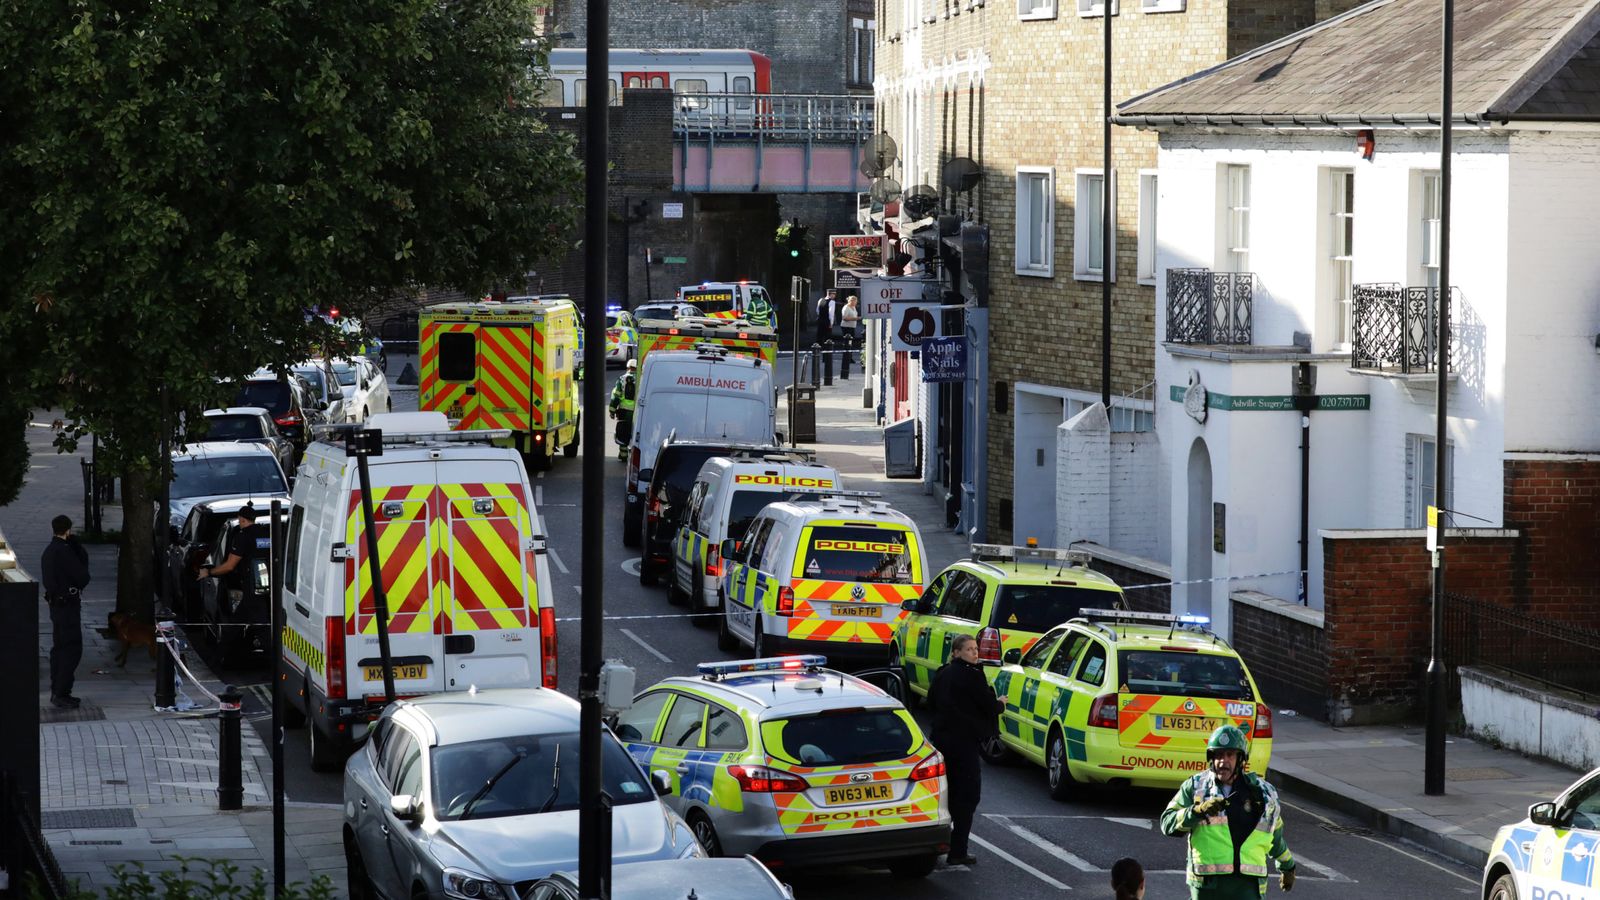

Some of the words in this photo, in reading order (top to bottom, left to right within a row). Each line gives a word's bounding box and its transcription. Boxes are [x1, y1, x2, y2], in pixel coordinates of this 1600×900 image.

[686, 293, 732, 302] POLICE
[880, 288, 903, 299] OFF
[927, 341, 962, 355] Apple
[930, 356, 960, 368] Nails
[676, 376, 746, 390] AMBULANCE
[1231, 399, 1257, 408] Ashville
[1258, 399, 1284, 409] Surgery
[735, 475, 833, 488] POLICE
[816, 540, 903, 553] POLICE
[730, 603, 752, 628] POLICE
[858, 607, 877, 616] FTP
[368, 667, 398, 680] MX6
[401, 665, 424, 678] VBV
[1226, 703, 1253, 716] NHS
[1162, 717, 1191, 730] LV63
[1194, 719, 1216, 731] LKY
[1121, 755, 1174, 769] LONDON
[829, 787, 862, 803] BV63
[865, 785, 888, 799] WLR
[814, 805, 911, 822] POLICE
[1532, 886, 1585, 900] PO
